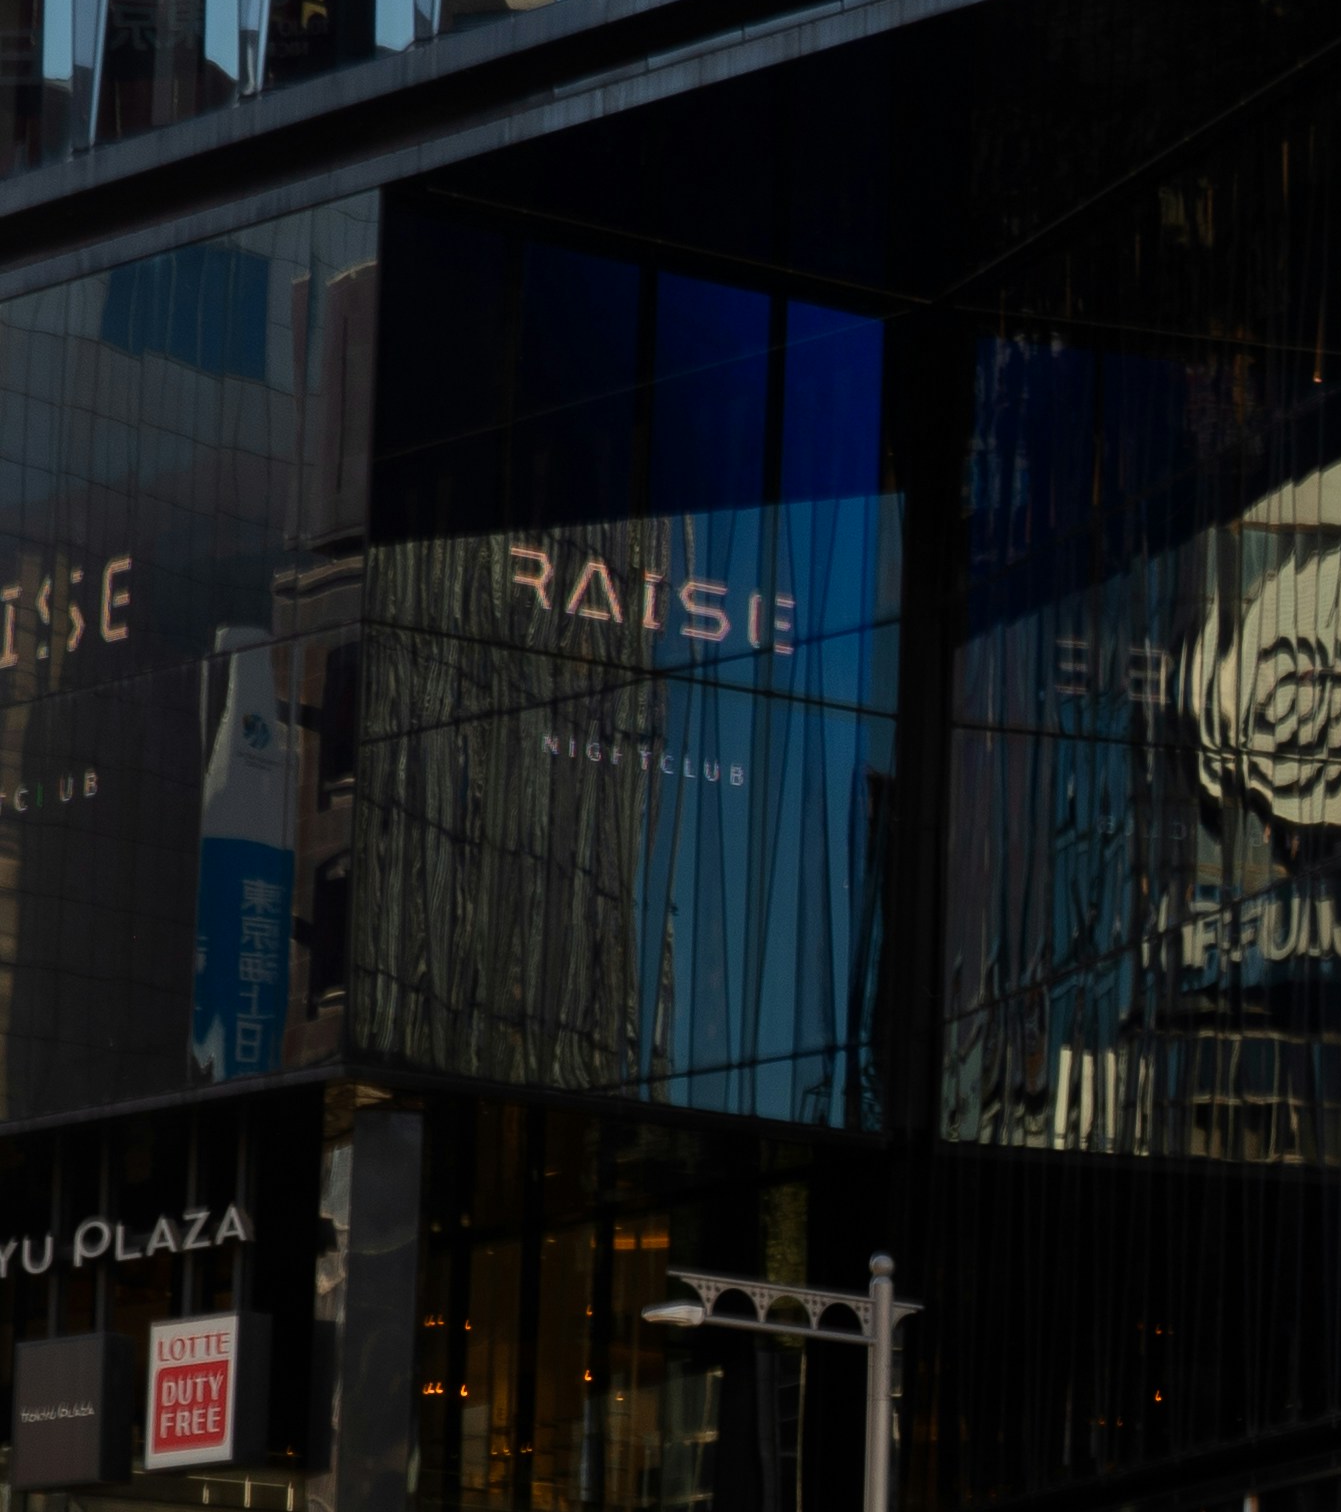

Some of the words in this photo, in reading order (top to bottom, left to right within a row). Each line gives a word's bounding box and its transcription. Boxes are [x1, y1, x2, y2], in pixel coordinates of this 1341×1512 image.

[510, 544, 797, 656] RAISE
[73, 1202, 252, 1269] PLAZA
[157, 1330, 231, 1363] LOTTE
[161, 1372, 225, 1407] DUTY
[159, 1406, 222, 1440] FREE
